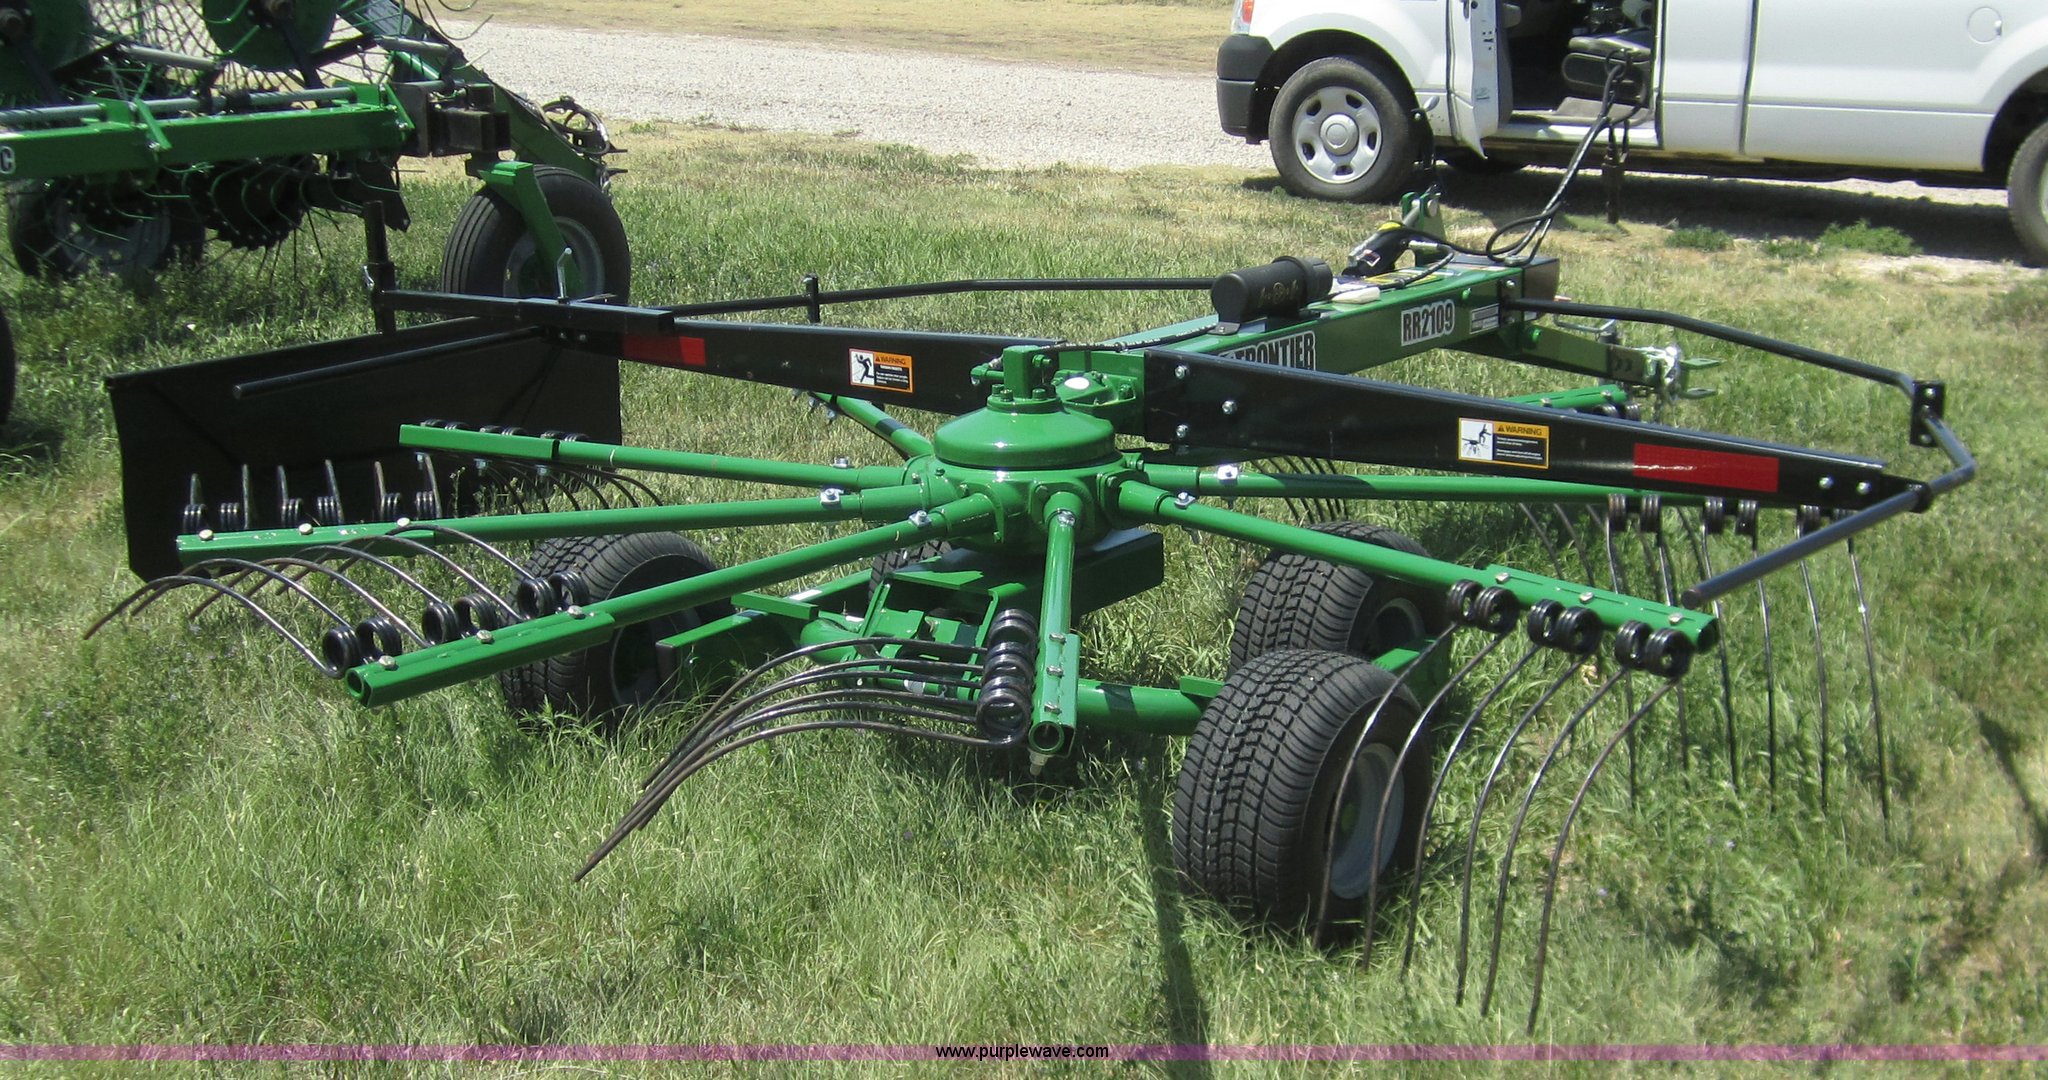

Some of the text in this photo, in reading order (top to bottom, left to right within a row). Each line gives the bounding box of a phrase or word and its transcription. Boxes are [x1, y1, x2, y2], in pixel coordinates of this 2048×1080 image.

[1402, 301, 1455, 342] RR2109
[1236, 334, 1316, 370] ONTIER
[1505, 425, 1542, 436] WARNING
